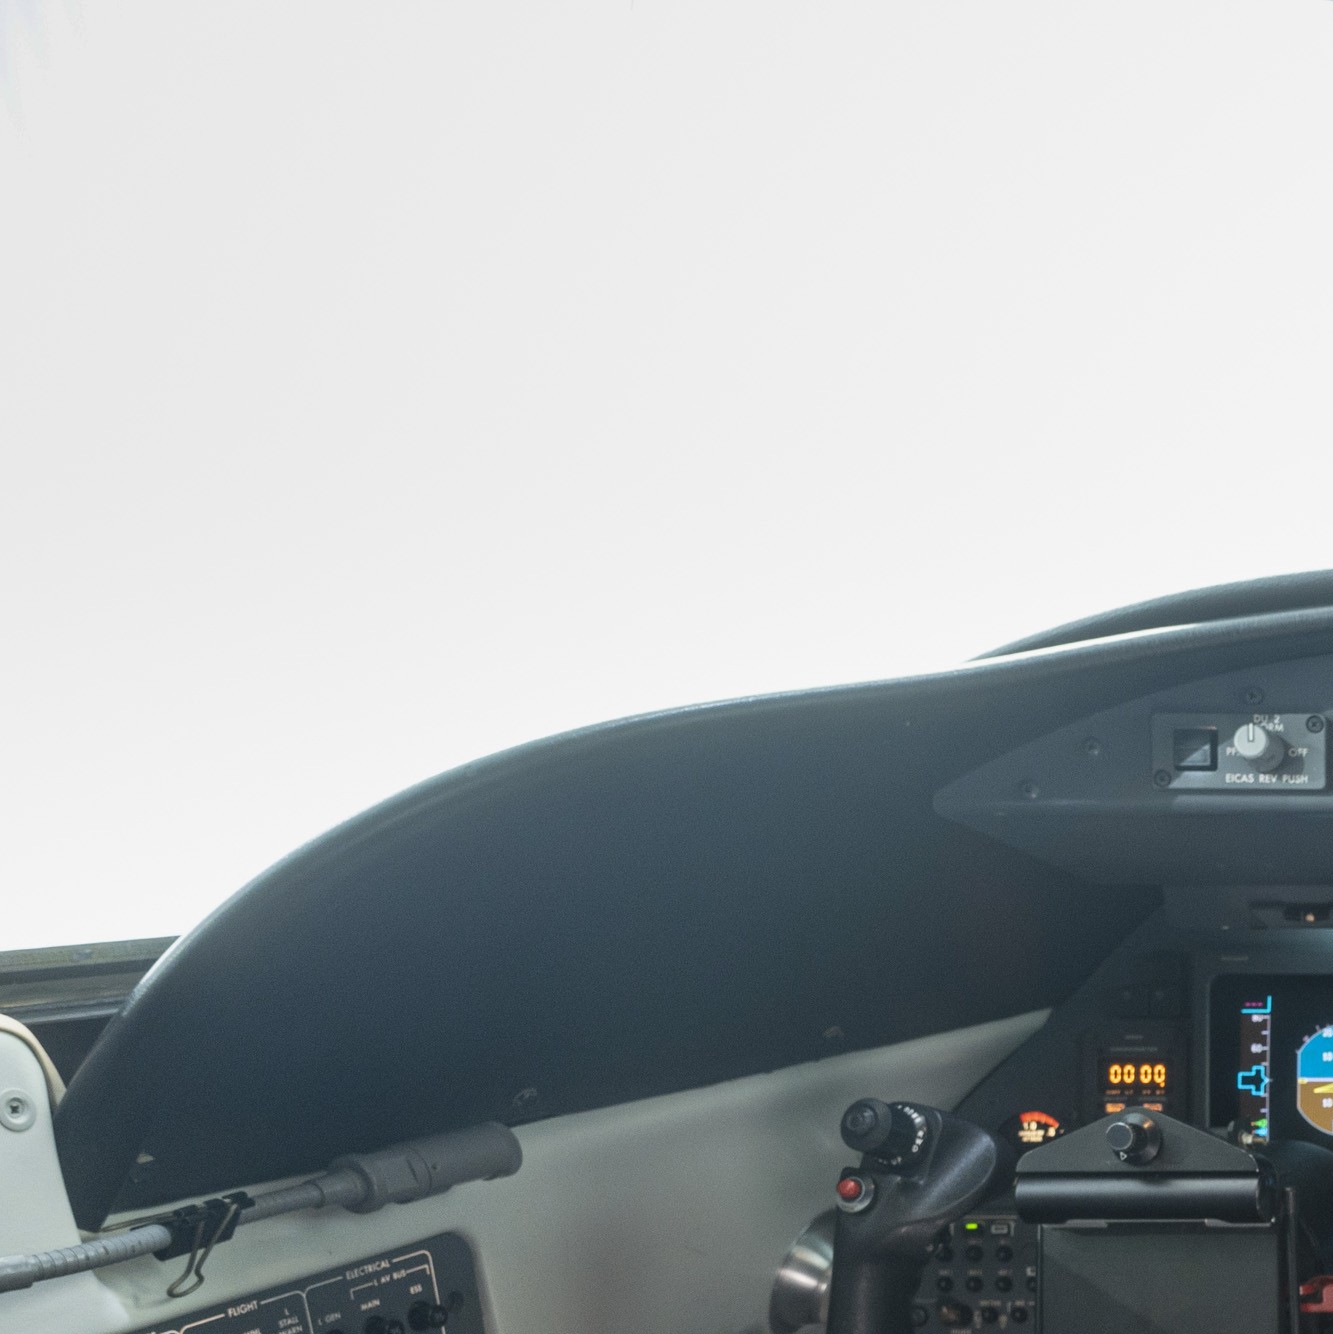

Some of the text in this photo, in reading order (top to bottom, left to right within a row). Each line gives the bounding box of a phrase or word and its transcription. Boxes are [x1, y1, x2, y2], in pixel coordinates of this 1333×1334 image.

[1225, 773, 1309, 784] EICAS REV PUSH
[346, 1260, 390, 1280] ELECTRICAL
[228, 1301, 259, 1318] FLIGHT
